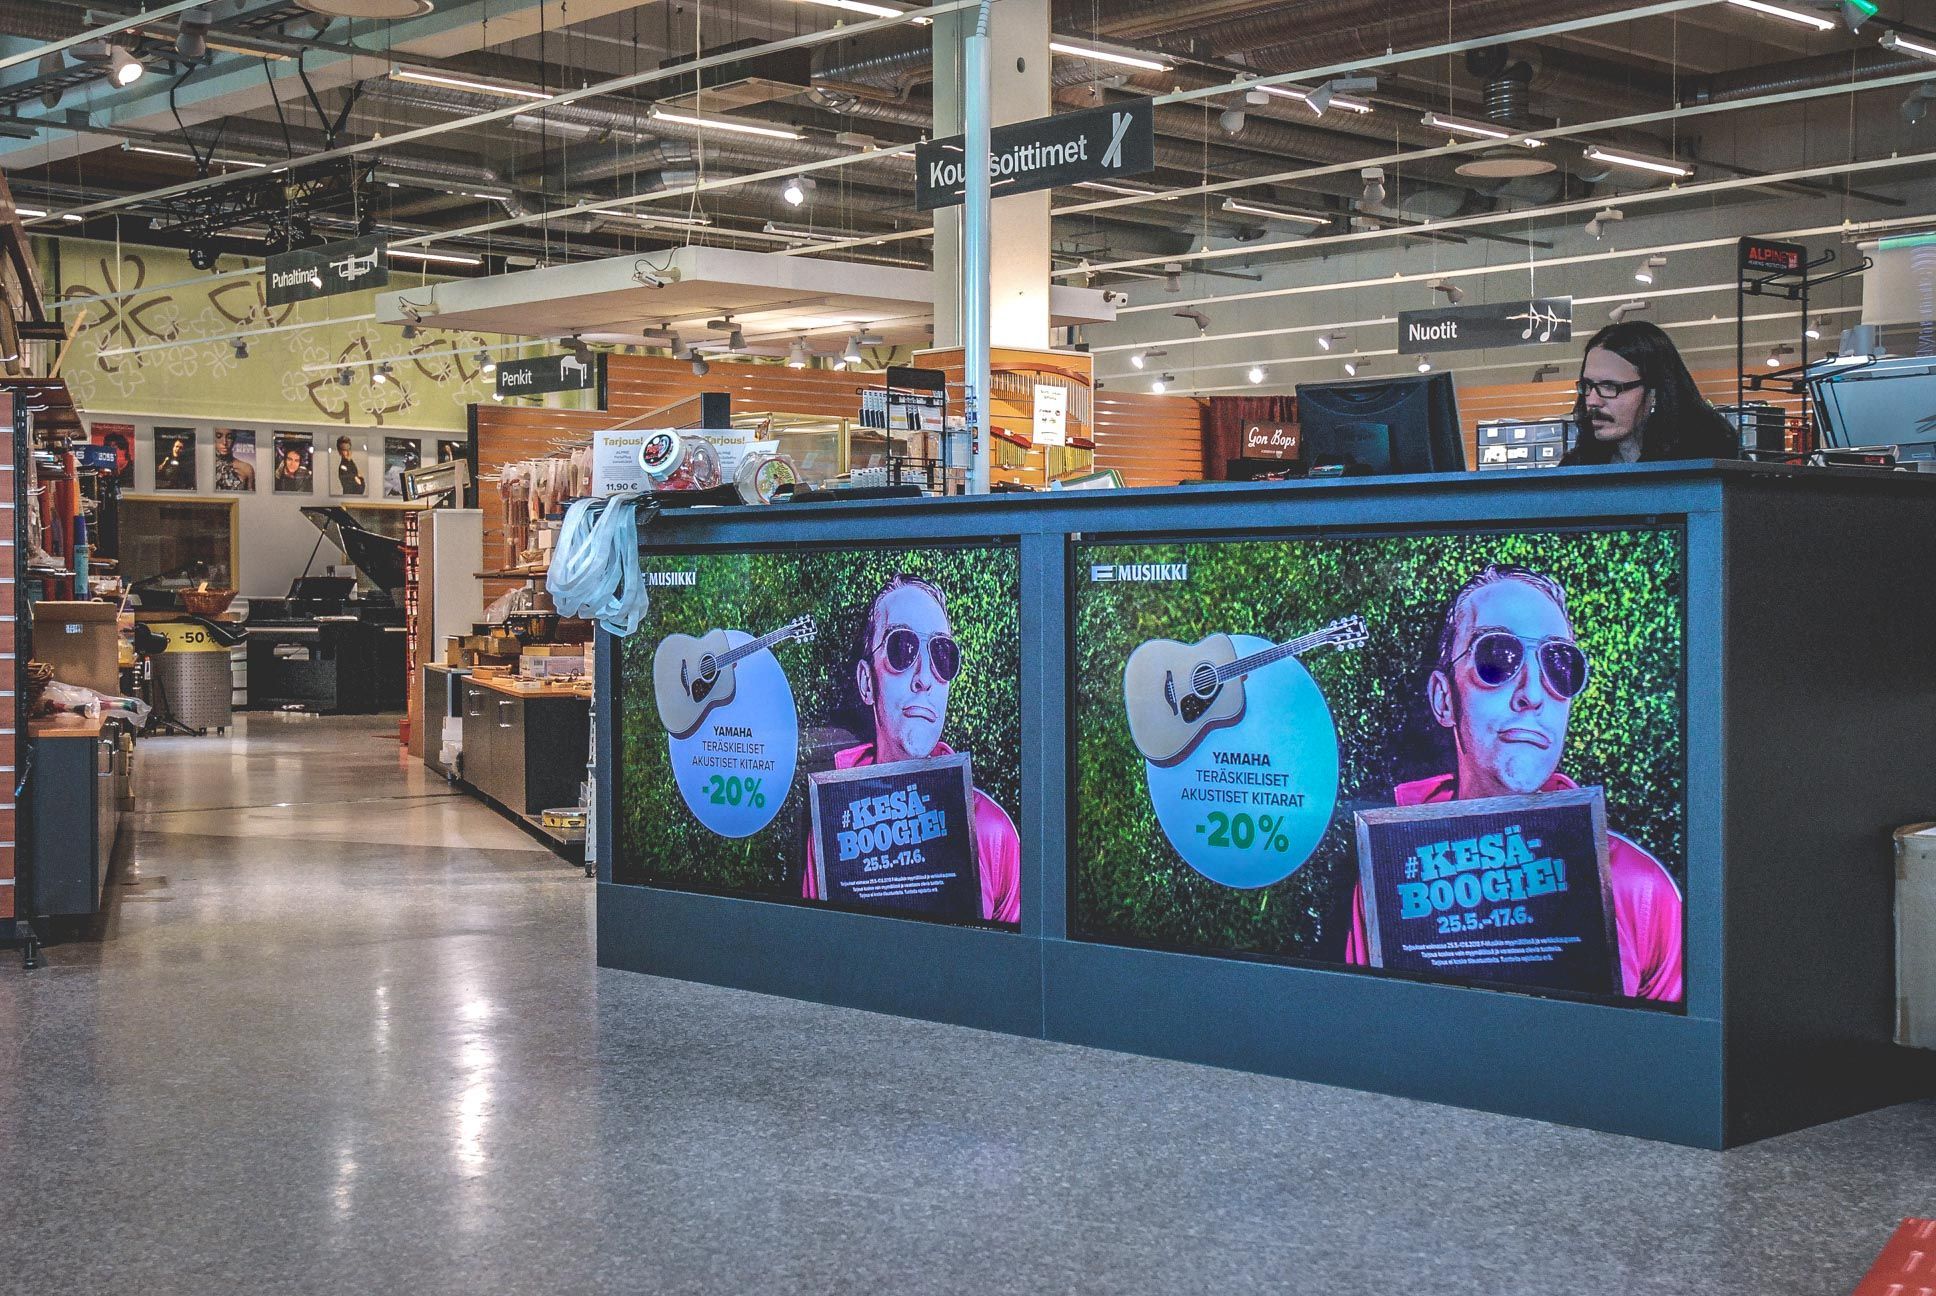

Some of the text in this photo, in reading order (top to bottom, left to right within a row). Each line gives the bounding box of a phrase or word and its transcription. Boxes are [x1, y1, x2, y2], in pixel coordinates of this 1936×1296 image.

[930, 134, 1088, 189] Kousoittimet
[272, 266, 318, 289] Puhaltimet
[1409, 321, 1458, 342] Nuotit
[502, 369, 533, 387] Penkit
[603, 436, 643, 448] Tarjous!
[704, 435, 745, 446] Tarjous!
[1248, 426, 1296, 450] Gon Bops
[606, 482, 638, 491] 11,90 €
[649, 571, 697, 586] MUSIIKKI
[1118, 563, 1188, 582] MUSIIKKI
[713, 725, 753, 738] YAMAHA
[702, 739, 765, 755] TERÄSKIELISET
[692, 755, 776, 772] AKUSTISET KITARAT
[1213, 751, 1271, 767] YAMAHA
[1196, 768, 1290, 788] TERÄSKIELISET
[702, 774, 765, 809] -20%
[1181, 787, 1306, 808] AKUSTISET KITARAT
[841, 783, 931, 830] #KESÄ-
[837, 809, 948, 862] BOOGIE!
[1195, 810, 1290, 853] -20%
[862, 848, 926, 873] 25.5.-17.6.
[1404, 824, 1542, 882] #KESÄ-
[1397, 857, 1568, 920] BOOGIE!
[1436, 906, 1534, 934] 25.5.-17.6.
